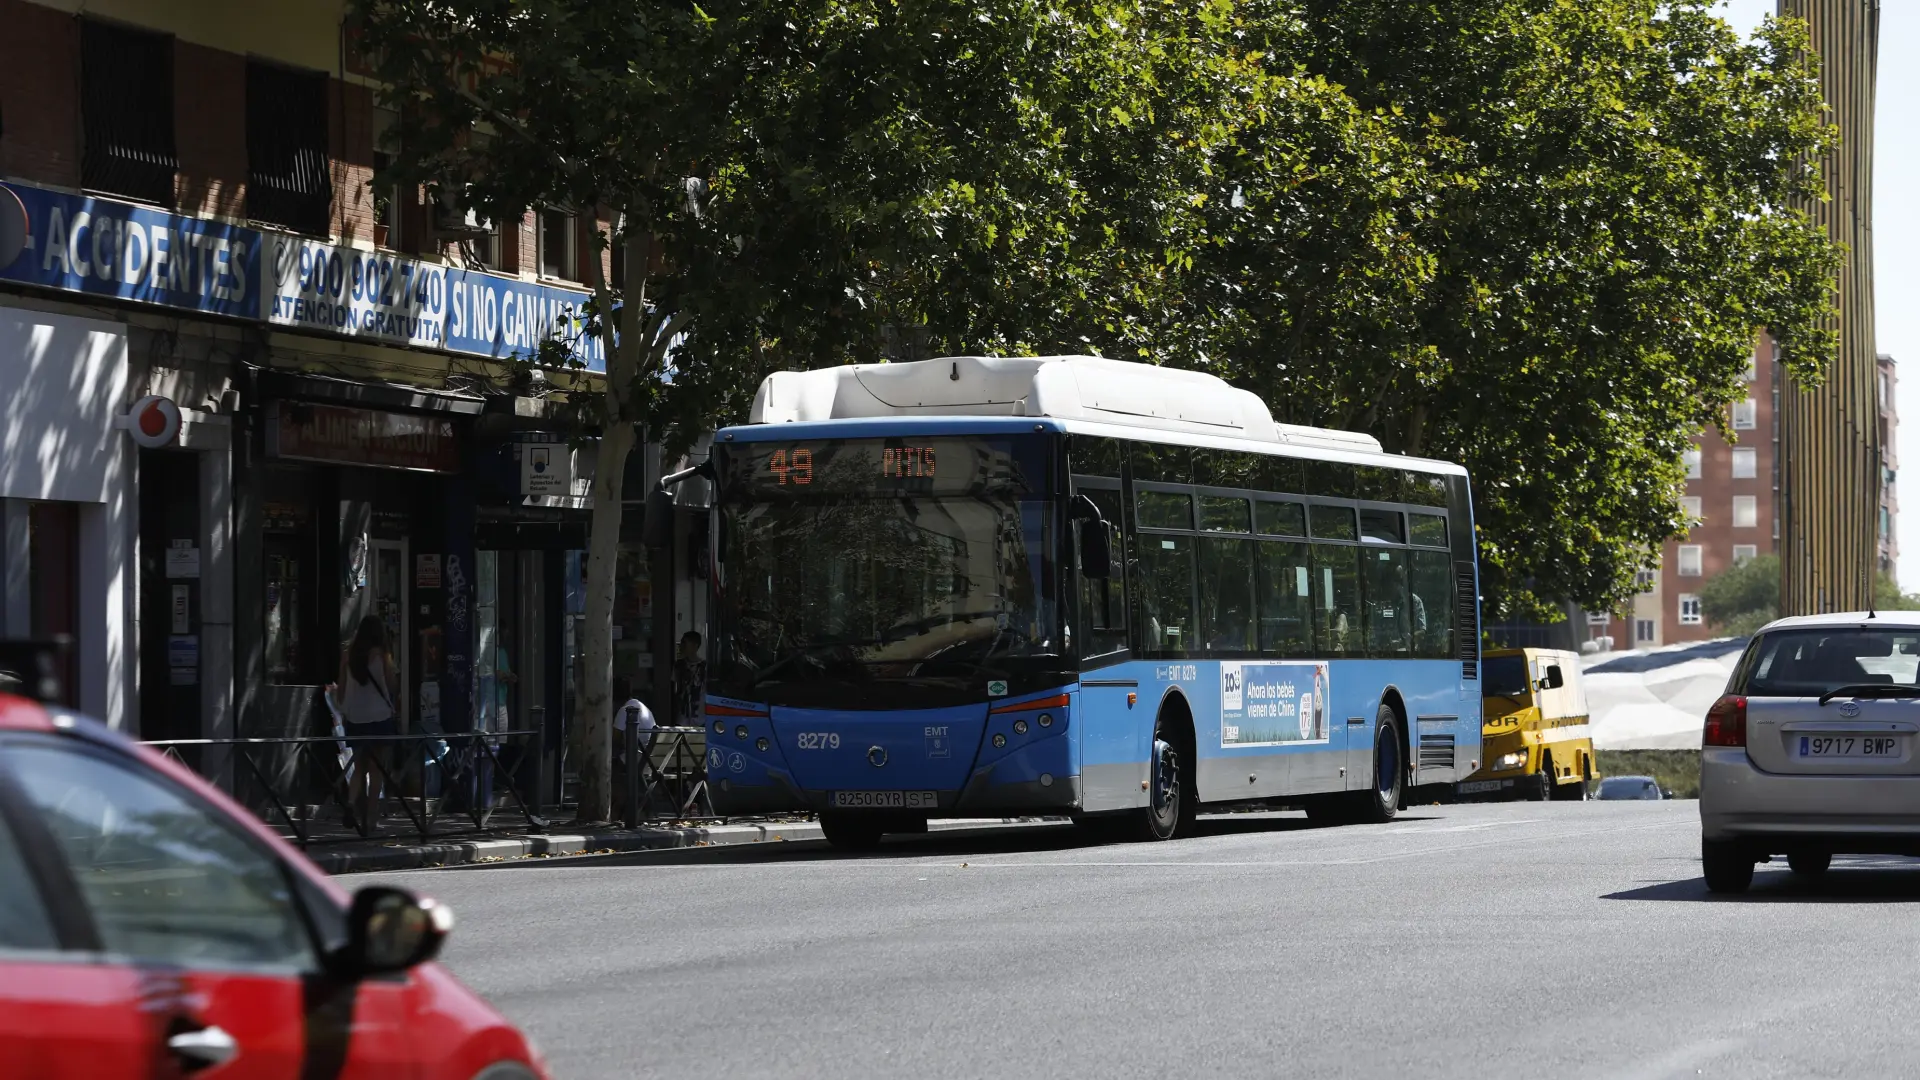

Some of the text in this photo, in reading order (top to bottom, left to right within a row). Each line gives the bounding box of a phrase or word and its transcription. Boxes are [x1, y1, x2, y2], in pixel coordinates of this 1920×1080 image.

[43, 206, 246, 302] ACCIDENTES
[300, 245, 442, 315] 900 902 740
[271, 294, 441, 342] ATENCION GRATUITA
[452, 280, 467, 338] SI
[472, 284, 497, 343] NO
[770, 447, 935, 485] 49 PITIS
[1168, 665, 1181, 681] EMT
[1182, 665, 1197, 681] 8279
[1247, 681, 1265, 699] Ahora
[1267, 681, 1276, 699] los
[1277, 680, 1295, 699] bebés
[1247, 700, 1295, 718] vienen de China
[924, 726, 948, 736] EMT
[1483, 717, 1518, 727] UR
[797, 732, 840, 749] 8279
[1812, 738, 1895, 754] 9717 BWP
[839, 792, 901, 805] 9250 GYR
